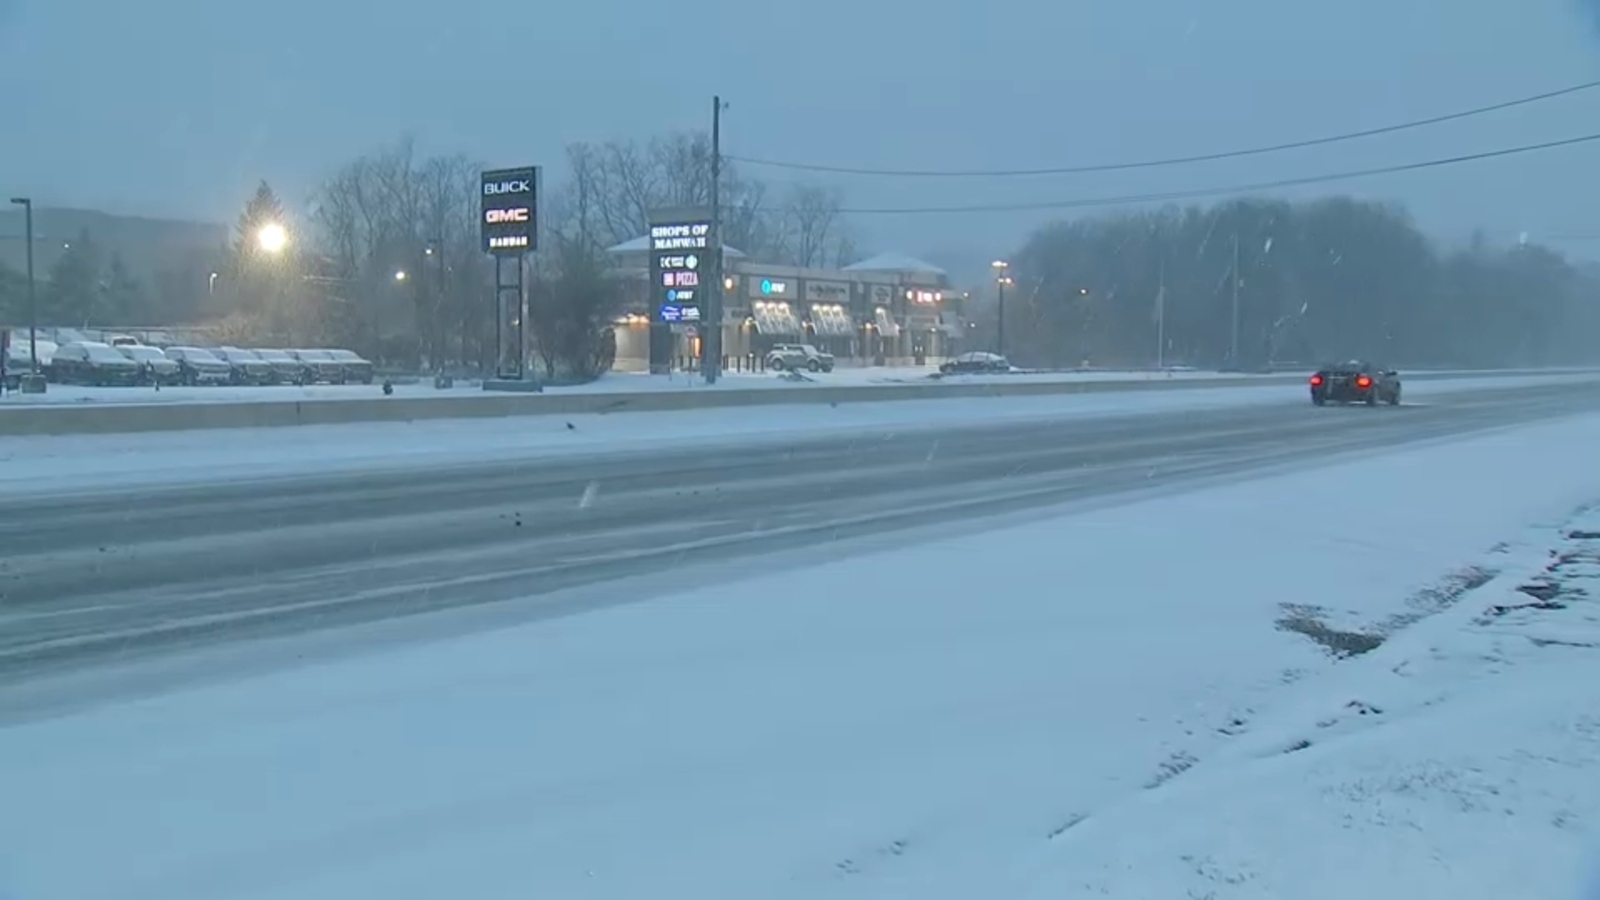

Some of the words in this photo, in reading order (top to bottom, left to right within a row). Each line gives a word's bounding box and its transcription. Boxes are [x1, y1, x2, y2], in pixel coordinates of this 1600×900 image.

[485, 180, 530, 195] BUICK
[486, 208, 528, 223] GMC
[651, 226, 690, 238] SHOPS
[692, 224, 709, 236] OF
